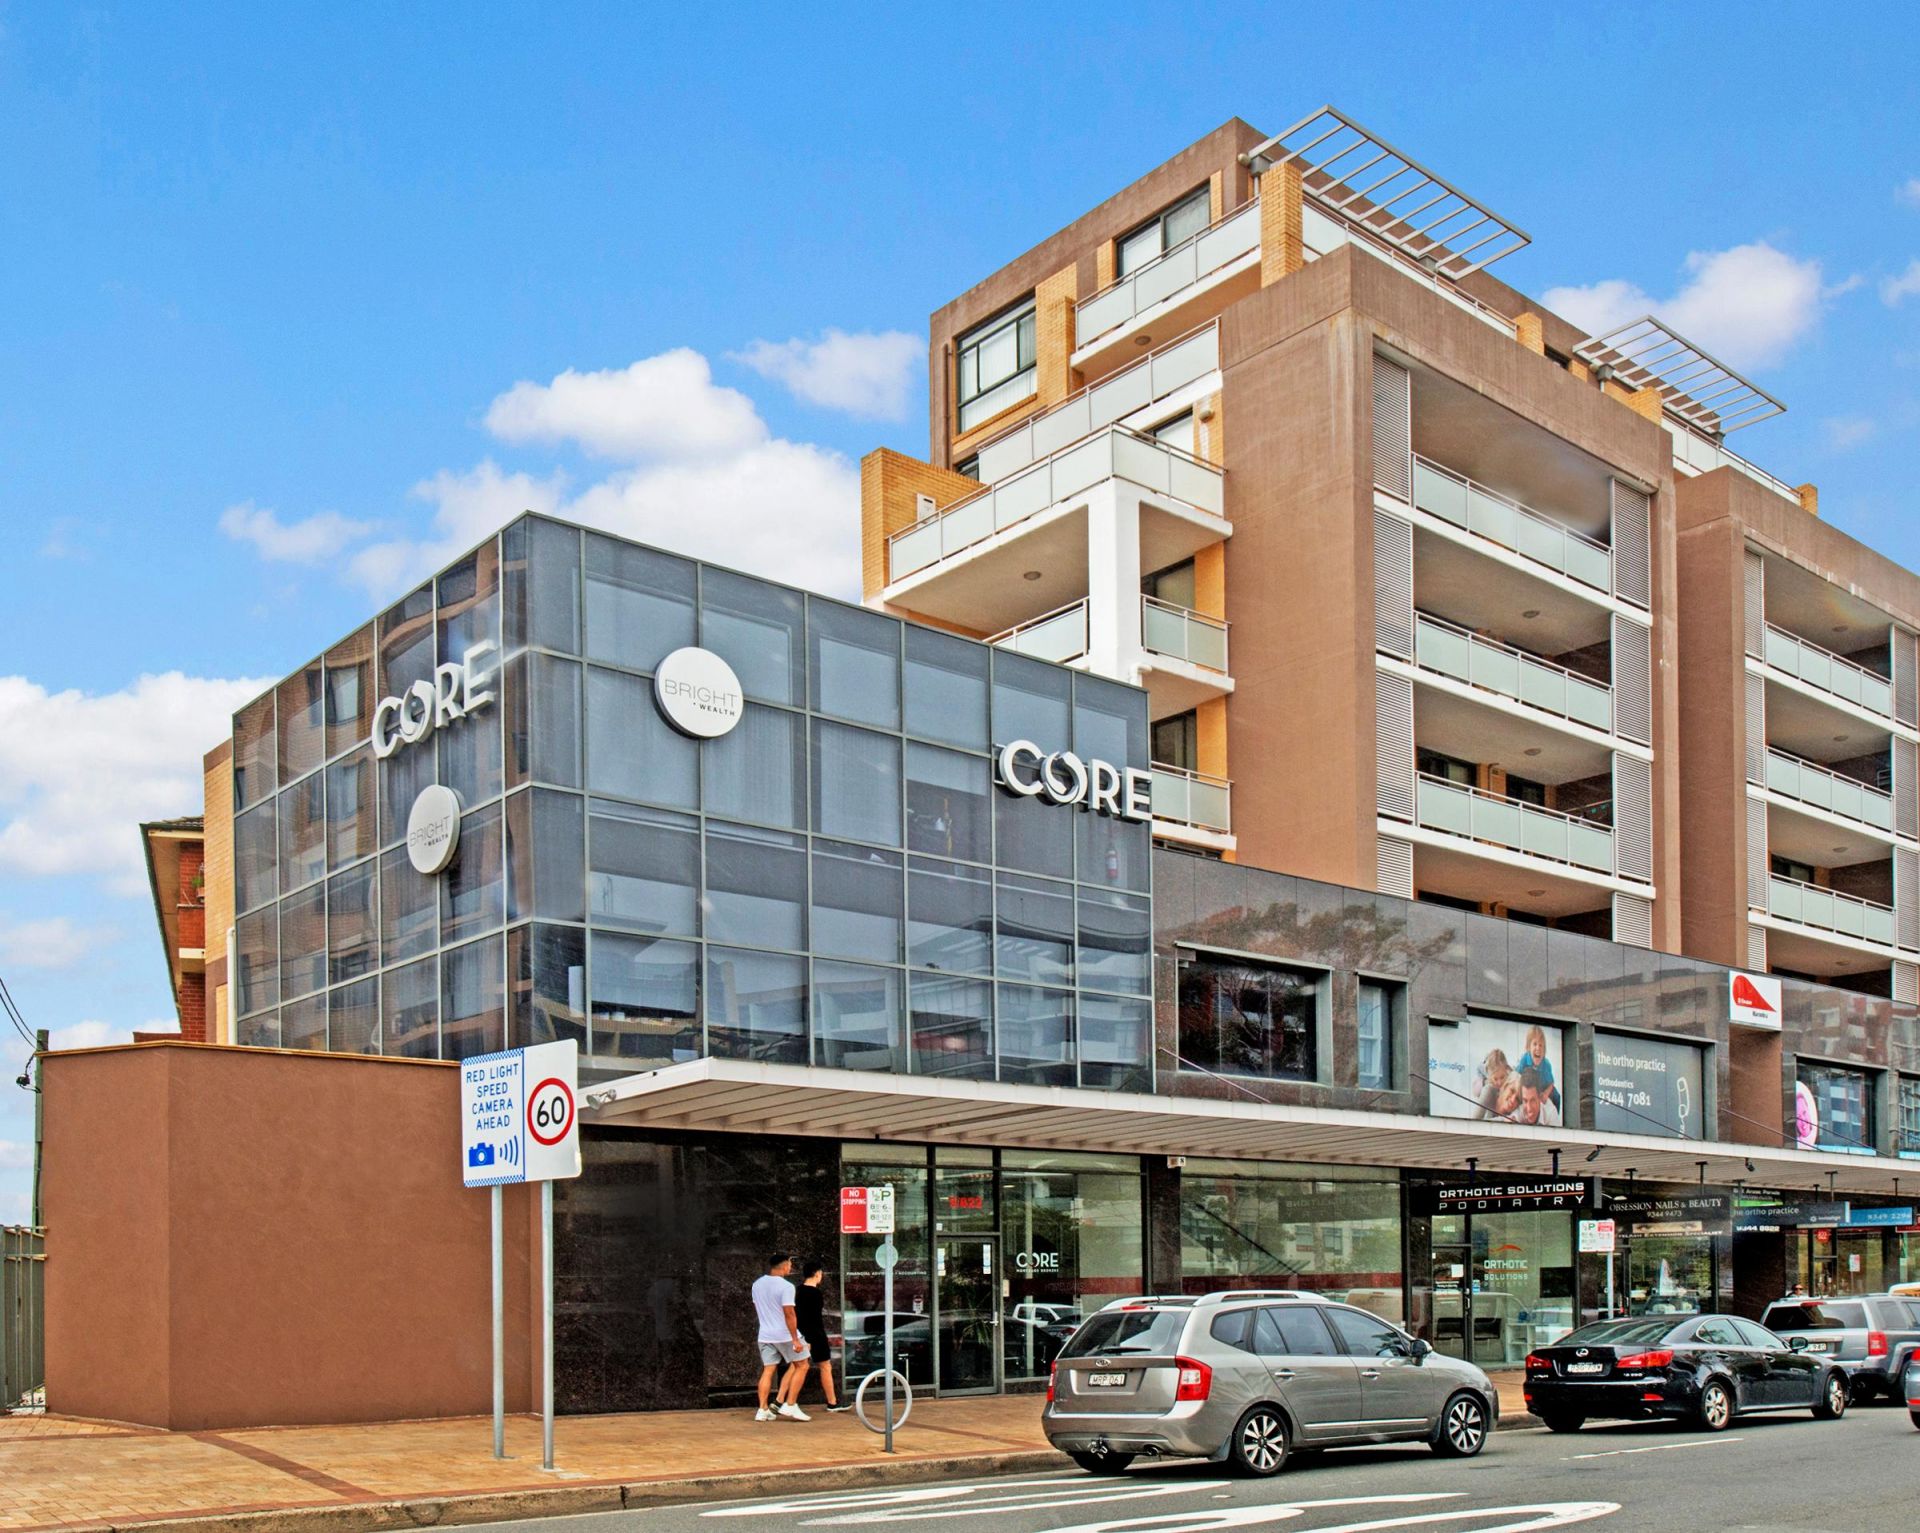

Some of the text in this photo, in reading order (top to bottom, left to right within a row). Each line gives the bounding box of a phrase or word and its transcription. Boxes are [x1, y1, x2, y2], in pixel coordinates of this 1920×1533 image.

[372, 638, 497, 759] CORE
[664, 679, 737, 708] BRIGHT
[700, 704, 735, 717] WEALTH
[999, 740, 1153, 821] CORE
[409, 815, 450, 847] BRIGHT
[1598, 1052, 1666, 1072] the ortho practice
[466, 1063, 519, 1083] RED LIGHT
[477, 1082, 508, 1098] SPEED
[1598, 1076, 1634, 1089] Orthodontics
[472, 1098, 513, 1115] CAMERA
[1598, 1090, 1651, 1108] 9344 7081
[537, 1096, 565, 1128] 60
[476, 1115, 510, 1131] AHEAD
[848, 1190, 860, 1198] NO
[1439, 1182, 1585, 1198] ORTHOTIC SOLUTIONS
[1439, 1196, 1585, 1210] PODIATRY
[1609, 1202, 1652, 1211] OBSESSION
[1655, 1201, 1679, 1209] NAILS
[1688, 1199, 1722, 1208] BEAUTY
[1768, 1207, 1799, 1217] practice
[1016, 1252, 1059, 1268] CORE
[1483, 1259, 1528, 1269] ORTHOTIC
